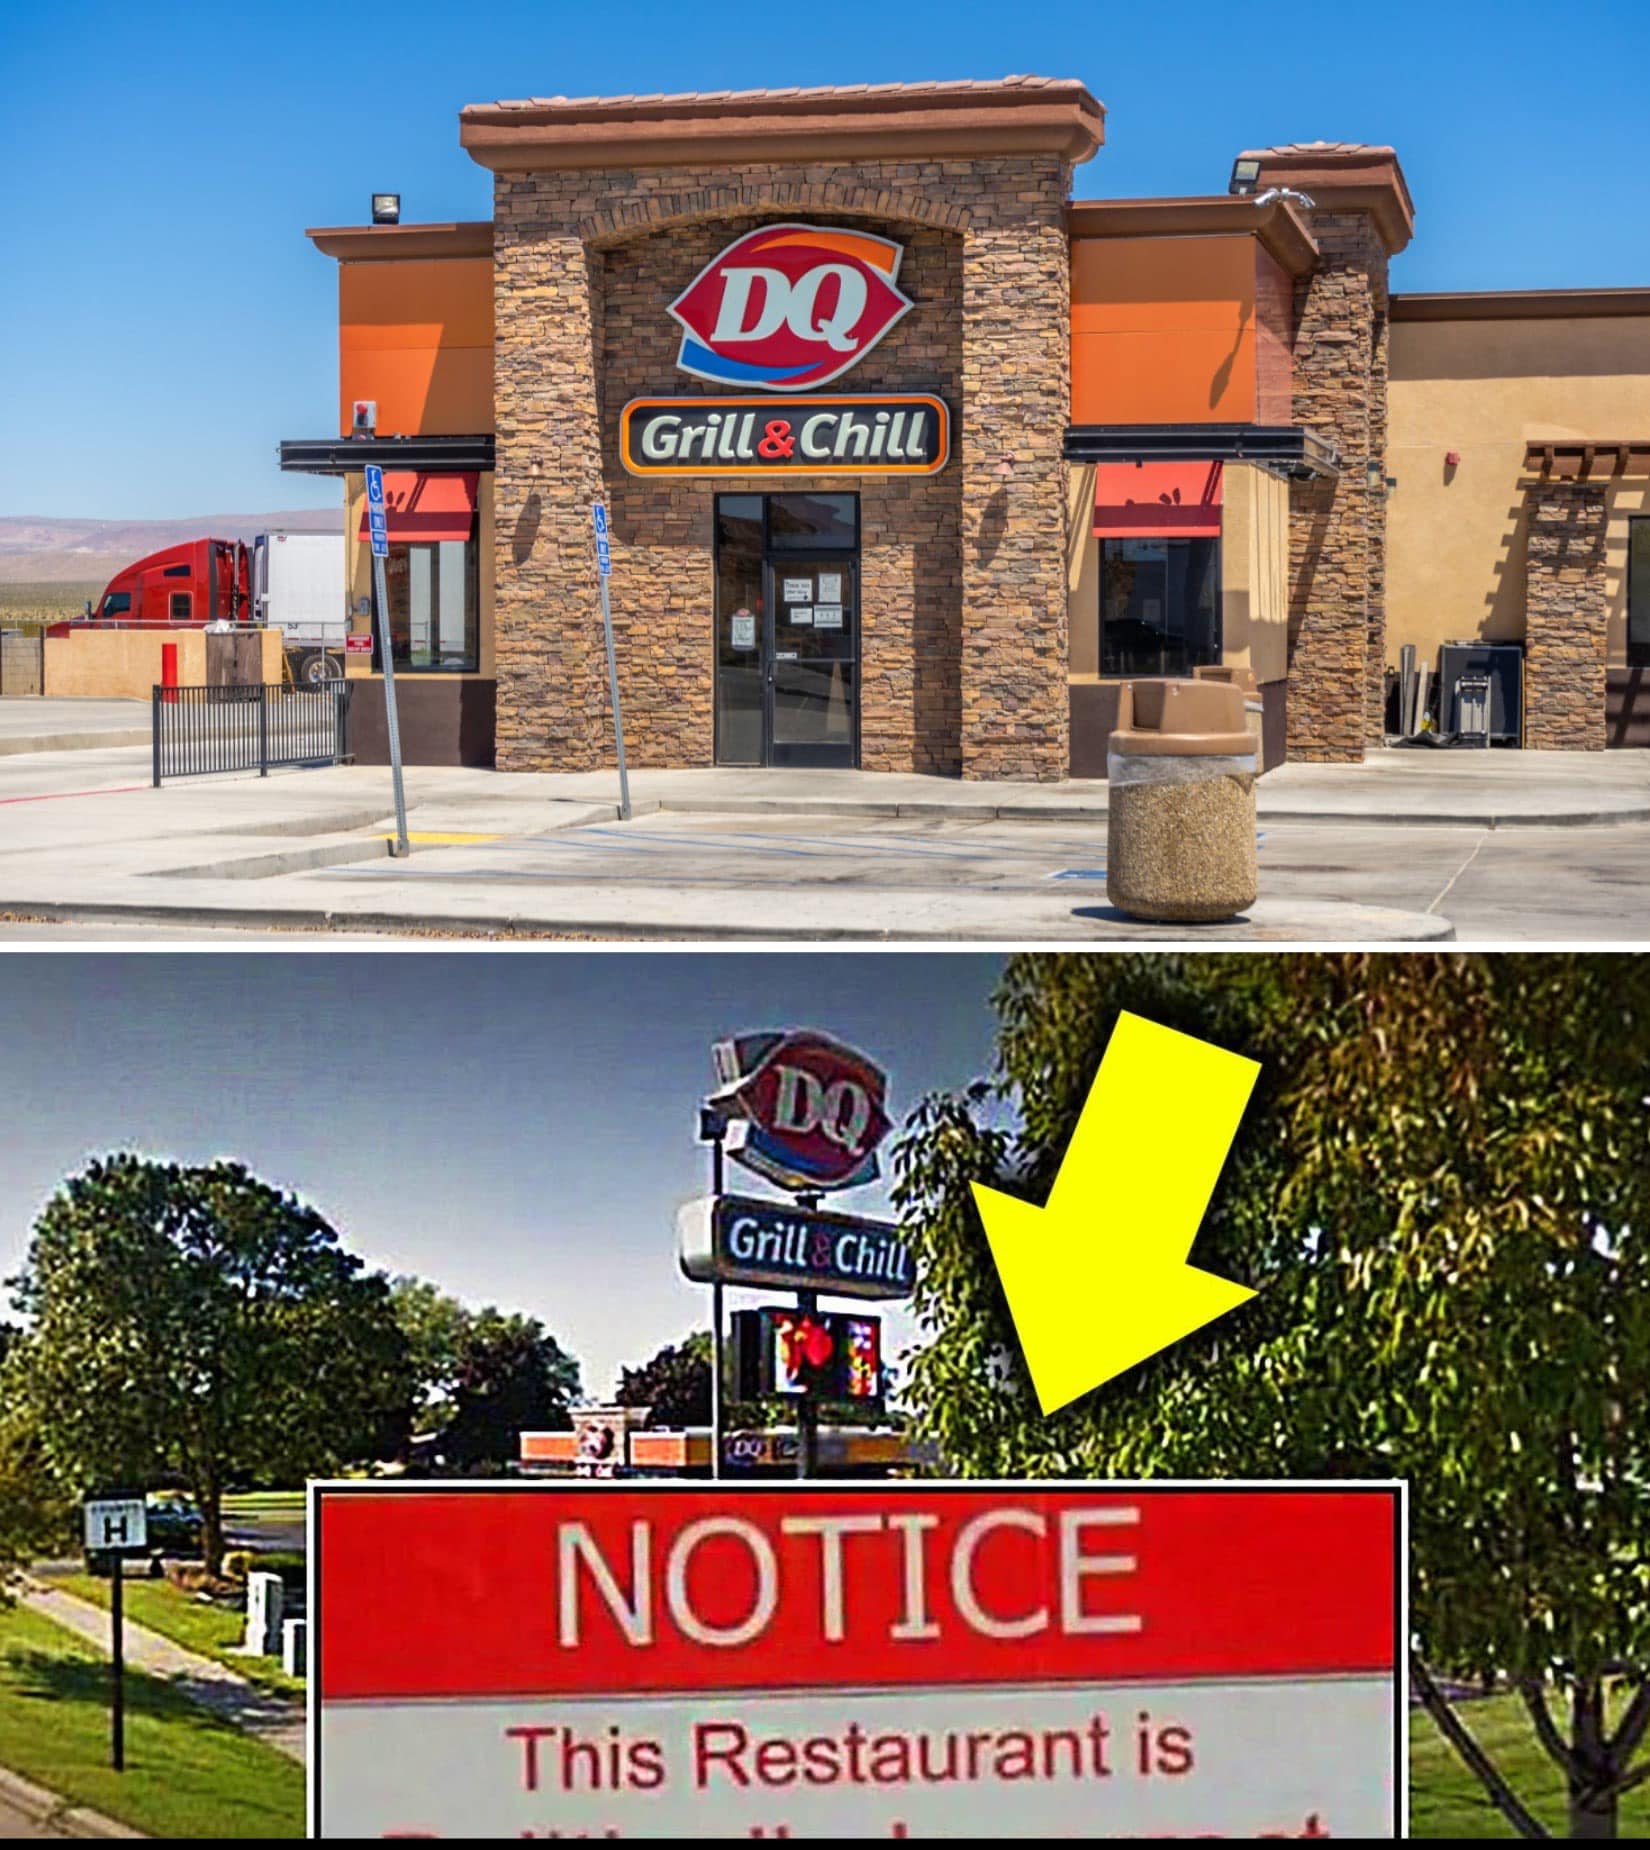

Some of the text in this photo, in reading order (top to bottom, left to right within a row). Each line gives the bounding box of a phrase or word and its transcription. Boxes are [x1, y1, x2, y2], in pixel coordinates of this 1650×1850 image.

[710, 264, 867, 352] DQ
[641, 412, 925, 459] Grill & Chill
[771, 1065, 871, 1156] DQ
[729, 1217, 908, 1282] Grill & Chill
[104, 1515, 128, 1545] H
[556, 1507, 1142, 1647] NOTICE
[506, 1712, 1194, 1793] This Restaurant is
